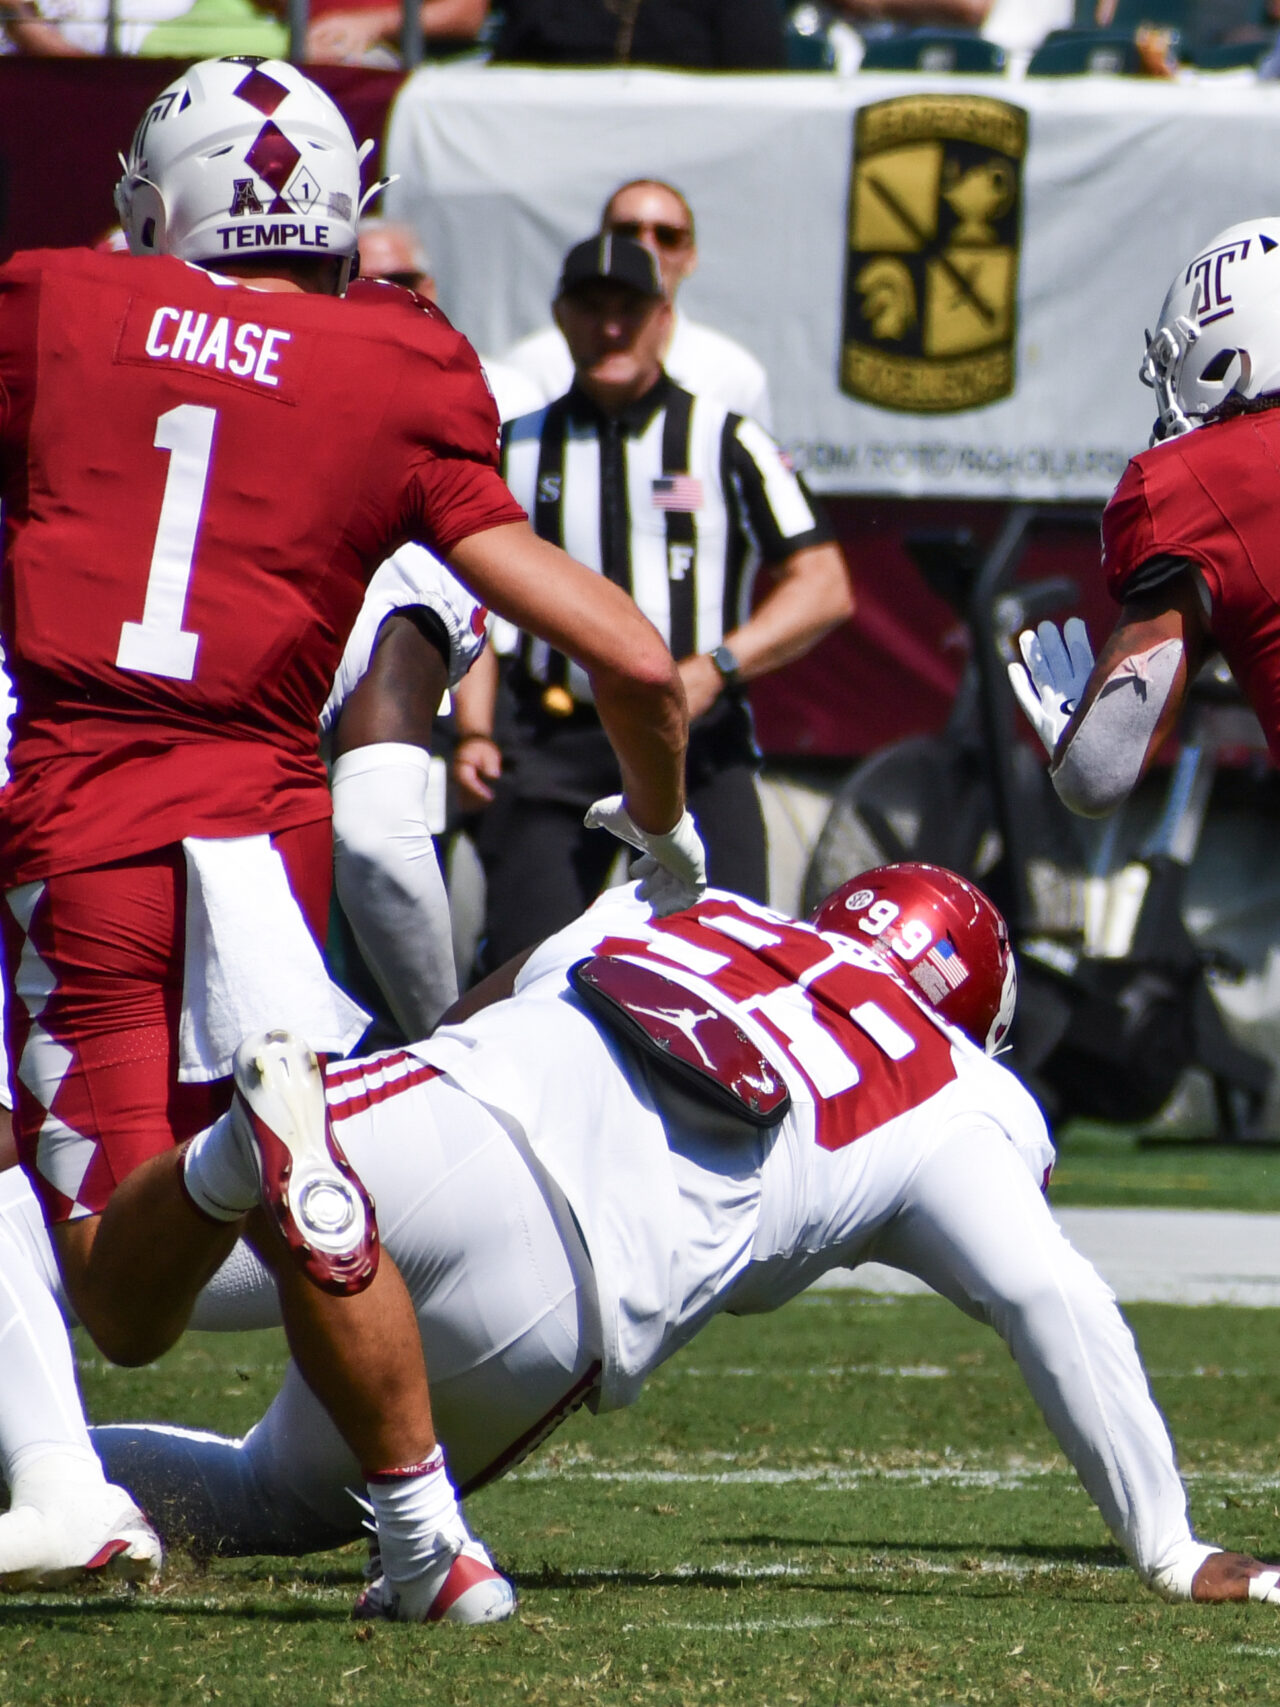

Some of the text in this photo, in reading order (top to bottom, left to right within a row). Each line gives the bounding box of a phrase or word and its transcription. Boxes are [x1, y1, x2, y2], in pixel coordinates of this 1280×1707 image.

[230, 178, 263, 217] A
[217, 224, 328, 249] TEMPLE
[145, 306, 292, 386] CHASE
[540, 475, 561, 502] S
[115, 403, 217, 681] 1
[669, 545, 694, 580] F
[858, 900, 932, 960] 99
